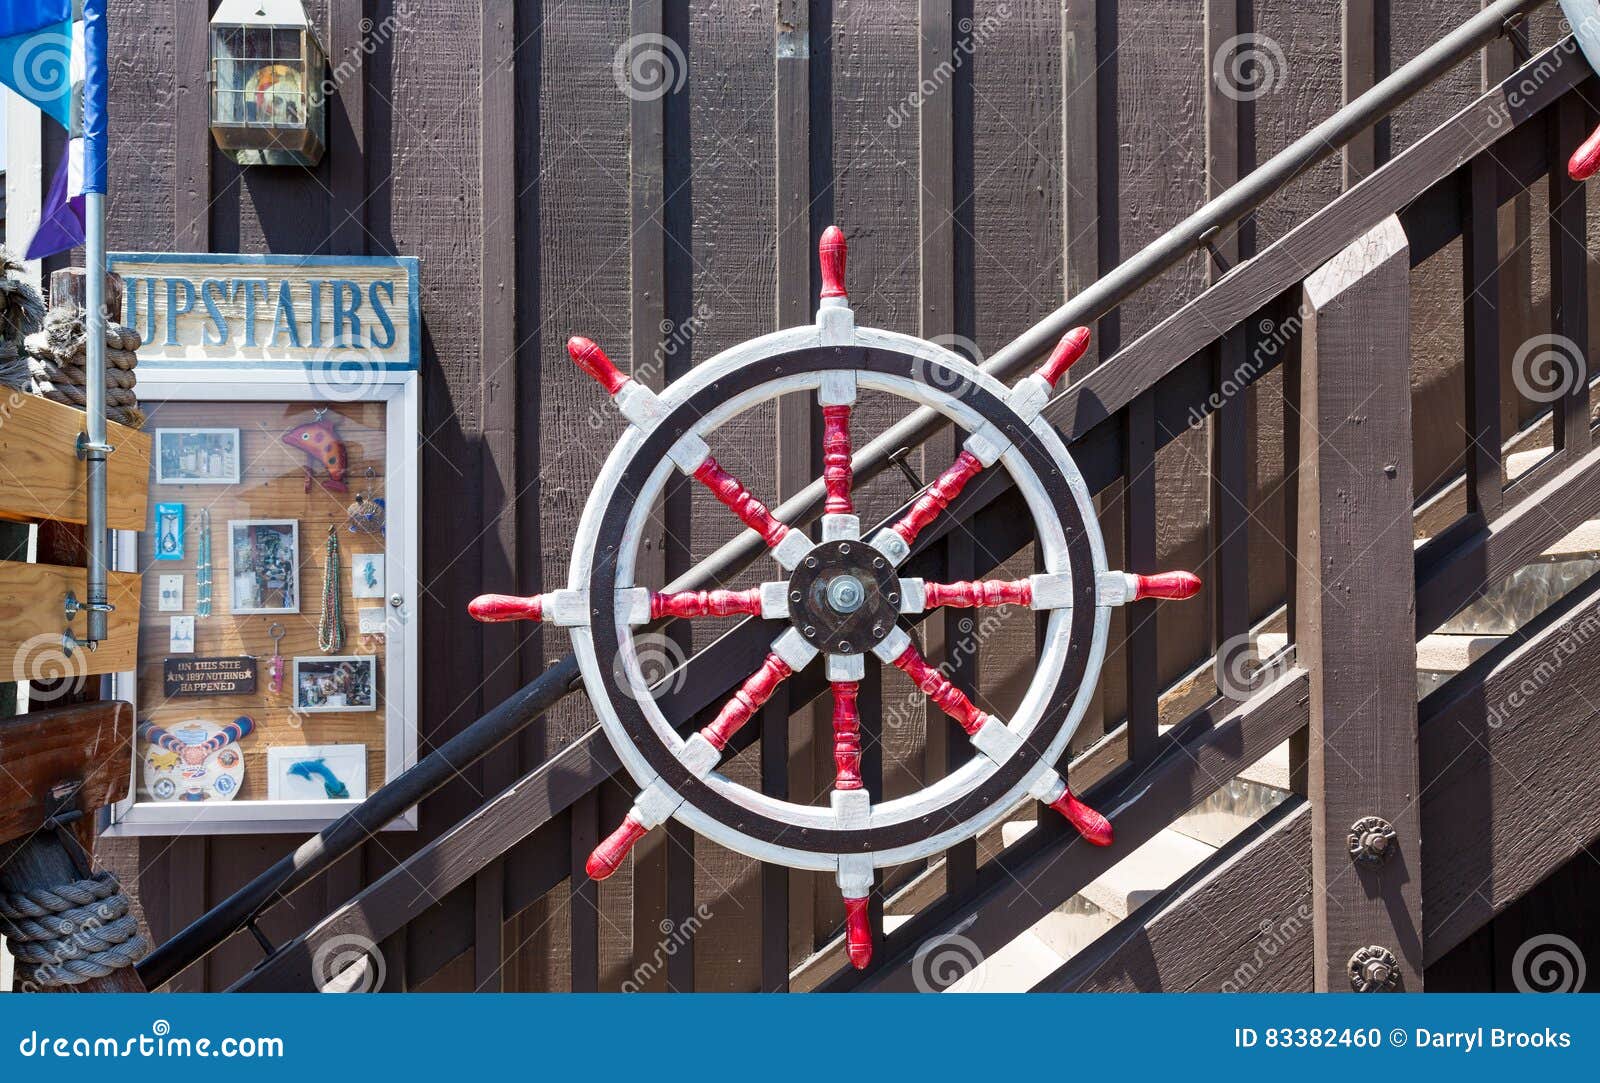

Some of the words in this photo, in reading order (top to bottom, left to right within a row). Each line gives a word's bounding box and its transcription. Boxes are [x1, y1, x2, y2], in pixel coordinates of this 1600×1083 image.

[122, 276, 396, 349] UPSTAIRS
[178, 662, 192, 671] ON
[194, 661, 217, 671] THIS
[219, 660, 241, 669] SITE
[174, 673, 184, 681] IN
[206, 671, 246, 680] NOTHING
[180, 682, 236, 692] HAPPENED
